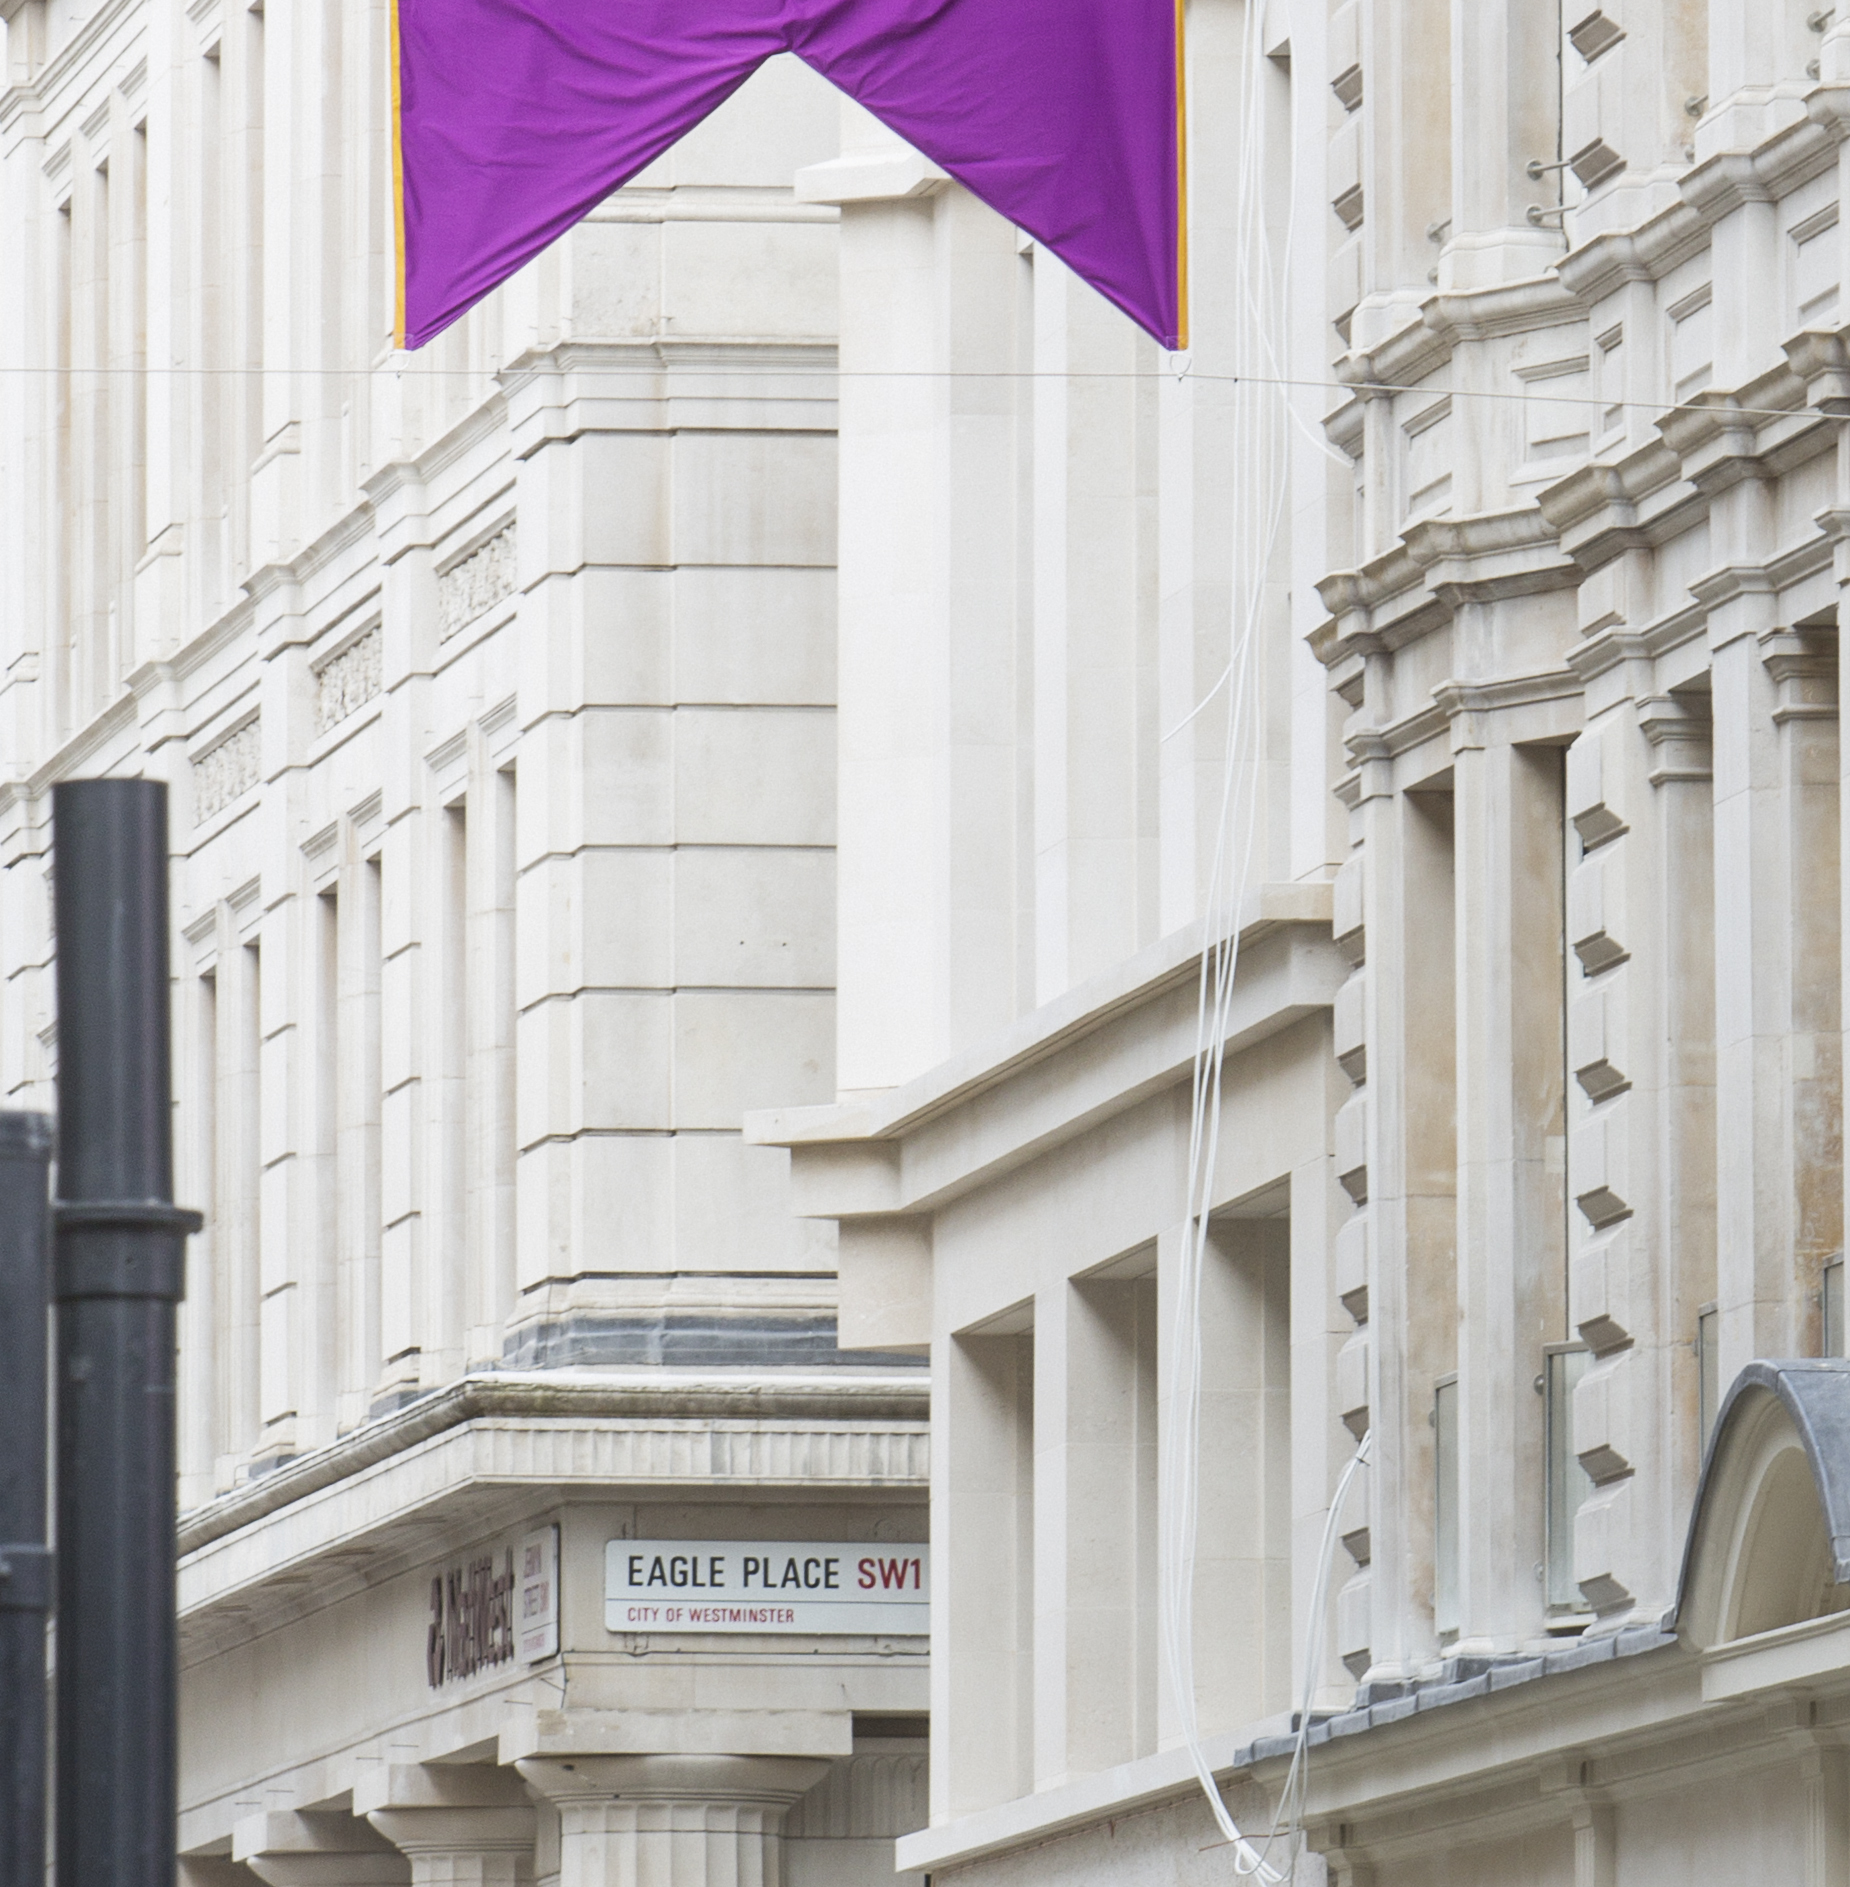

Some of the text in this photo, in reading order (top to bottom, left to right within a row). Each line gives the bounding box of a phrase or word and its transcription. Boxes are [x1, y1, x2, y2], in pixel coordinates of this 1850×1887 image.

[627, 1555, 922, 1589] EAGLE PLACE SW1
[627, 1607, 795, 1624] CITY OF WESTMINSTER
